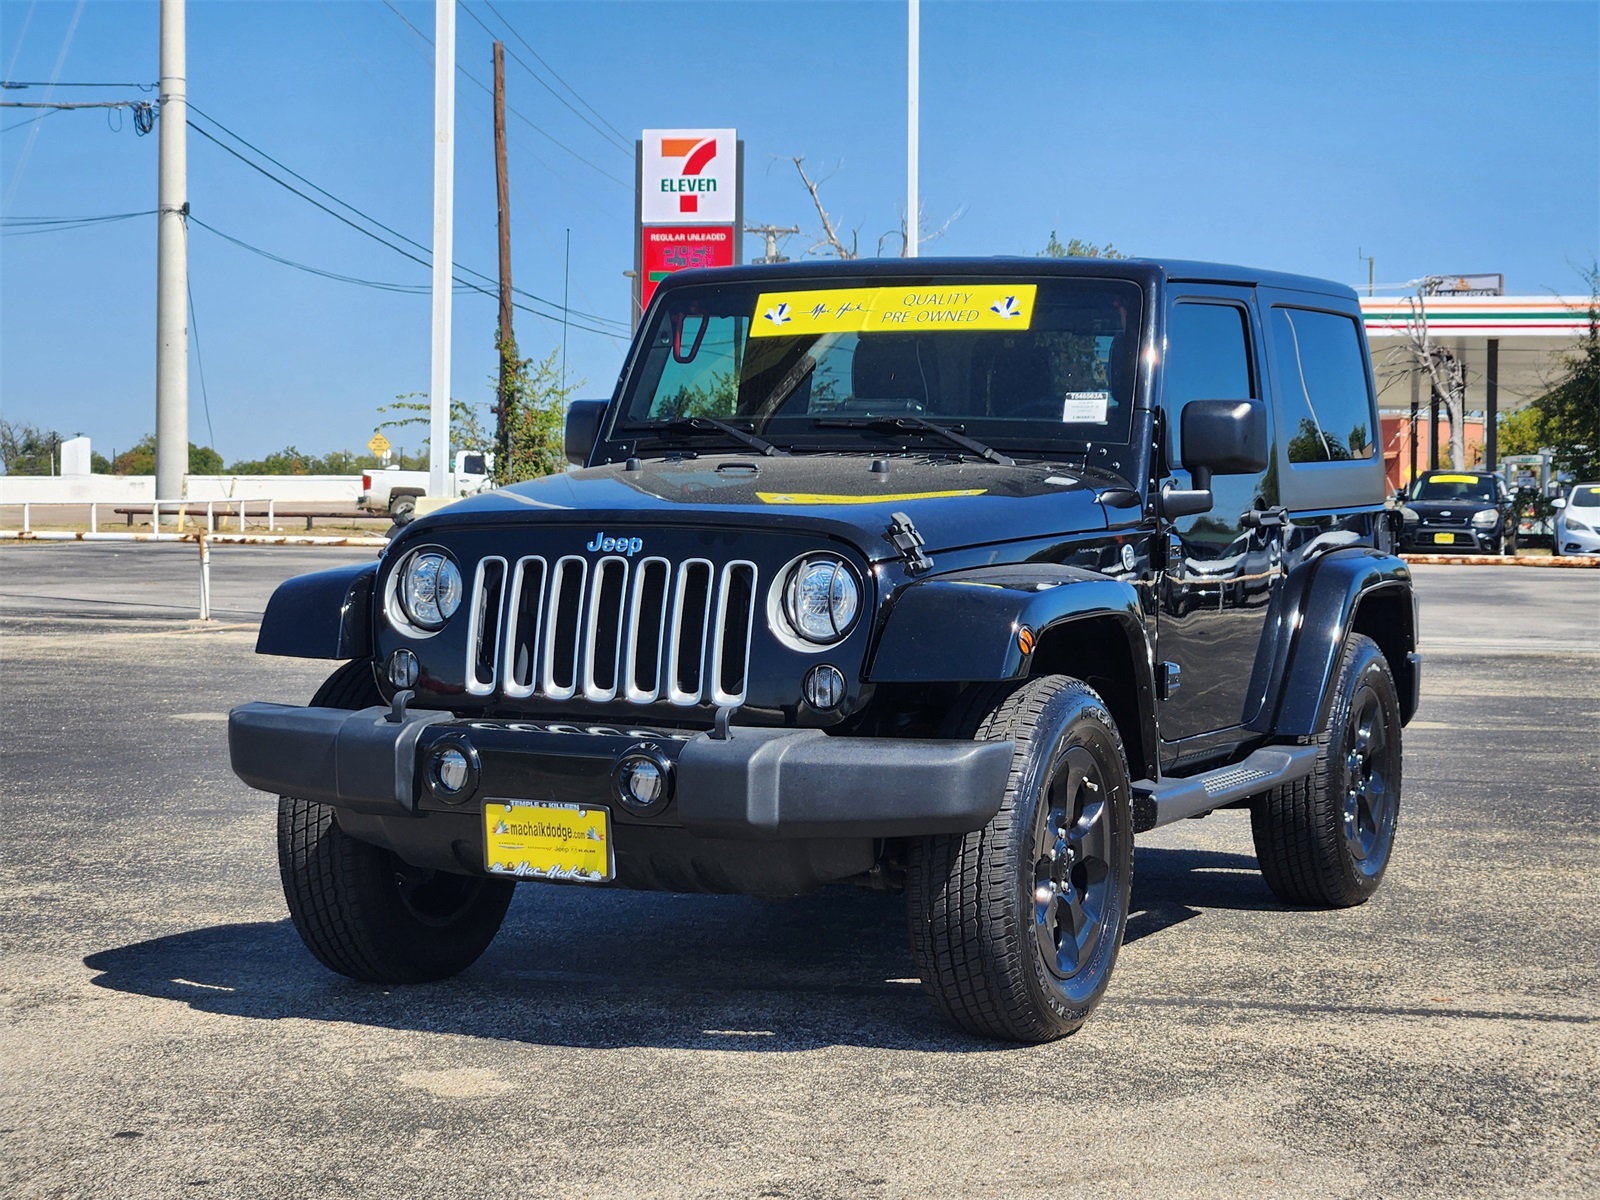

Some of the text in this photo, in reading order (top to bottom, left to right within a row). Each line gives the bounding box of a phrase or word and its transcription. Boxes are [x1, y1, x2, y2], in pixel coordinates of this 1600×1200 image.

[650, 233, 727, 242] REGULAR UNLEADED
[903, 292, 974, 306] QUALITY
[586, 531, 643, 557] Jeep
[509, 799, 580, 811] TEMPLE KILLEEN
[510, 820, 586, 842] machaikdodge.com
[513, 860, 582, 880] Mac Haik
